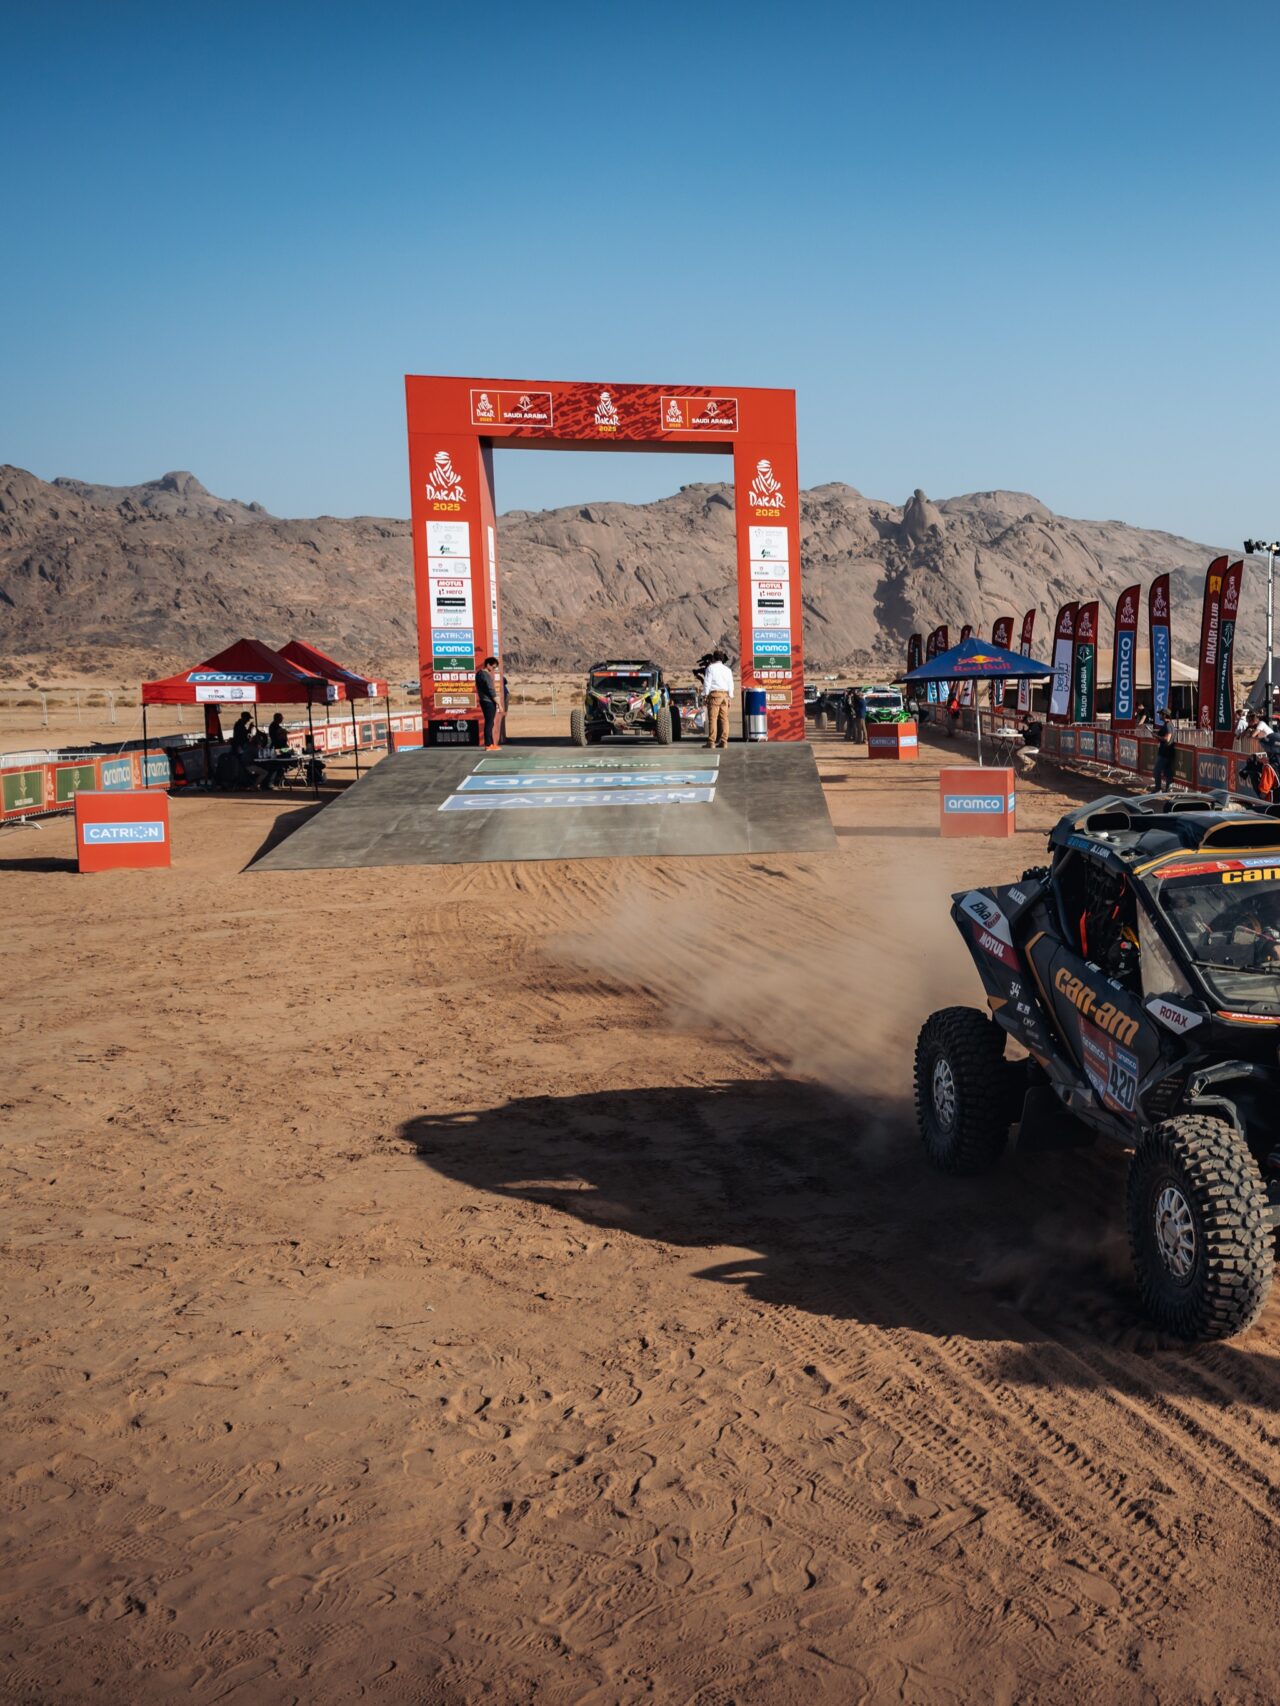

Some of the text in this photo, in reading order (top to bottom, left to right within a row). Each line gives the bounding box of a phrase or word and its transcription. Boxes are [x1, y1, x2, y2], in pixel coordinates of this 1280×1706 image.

[477, 410, 495, 418] DAKAR
[524, 412, 548, 420] ARABIA
[595, 414, 621, 426] DAKAR
[666, 415, 684, 424] DAKAR
[426, 484, 467, 502] DAKAR
[749, 491, 786, 508] DAKAR
[433, 503, 461, 512] 2025
[756, 509, 780, 517] 2025
[1120, 614, 1136, 624] DAKAR
[1206, 602, 1219, 664] DAKAR CLUB
[756, 644, 788, 652] aramco
[953, 662, 1012, 672] Red Bull
[195, 674, 266, 682] aramco
[1118, 637, 1132, 713] aramco
[1218, 693, 1226, 724] SAUDI
[103, 766, 131, 786] aramco
[1200, 760, 1226, 782] aramco
[484, 772, 697, 786] aramco
[463, 791, 696, 805] CATRION
[948, 798, 1000, 810] aramco
[90, 827, 158, 839] CATRION
[1008, 886, 1027, 905] MAXXIS
[970, 902, 992, 920] Elka
[980, 932, 1004, 958] MOTUL
[1054, 967, 1140, 1048] can-am
[1160, 1004, 1188, 1028] ROTAX
[1232, 1012, 1274, 1020] MOTUL
[1116, 1052, 1137, 1069] aramco
[1110, 1061, 1136, 1111] 420
